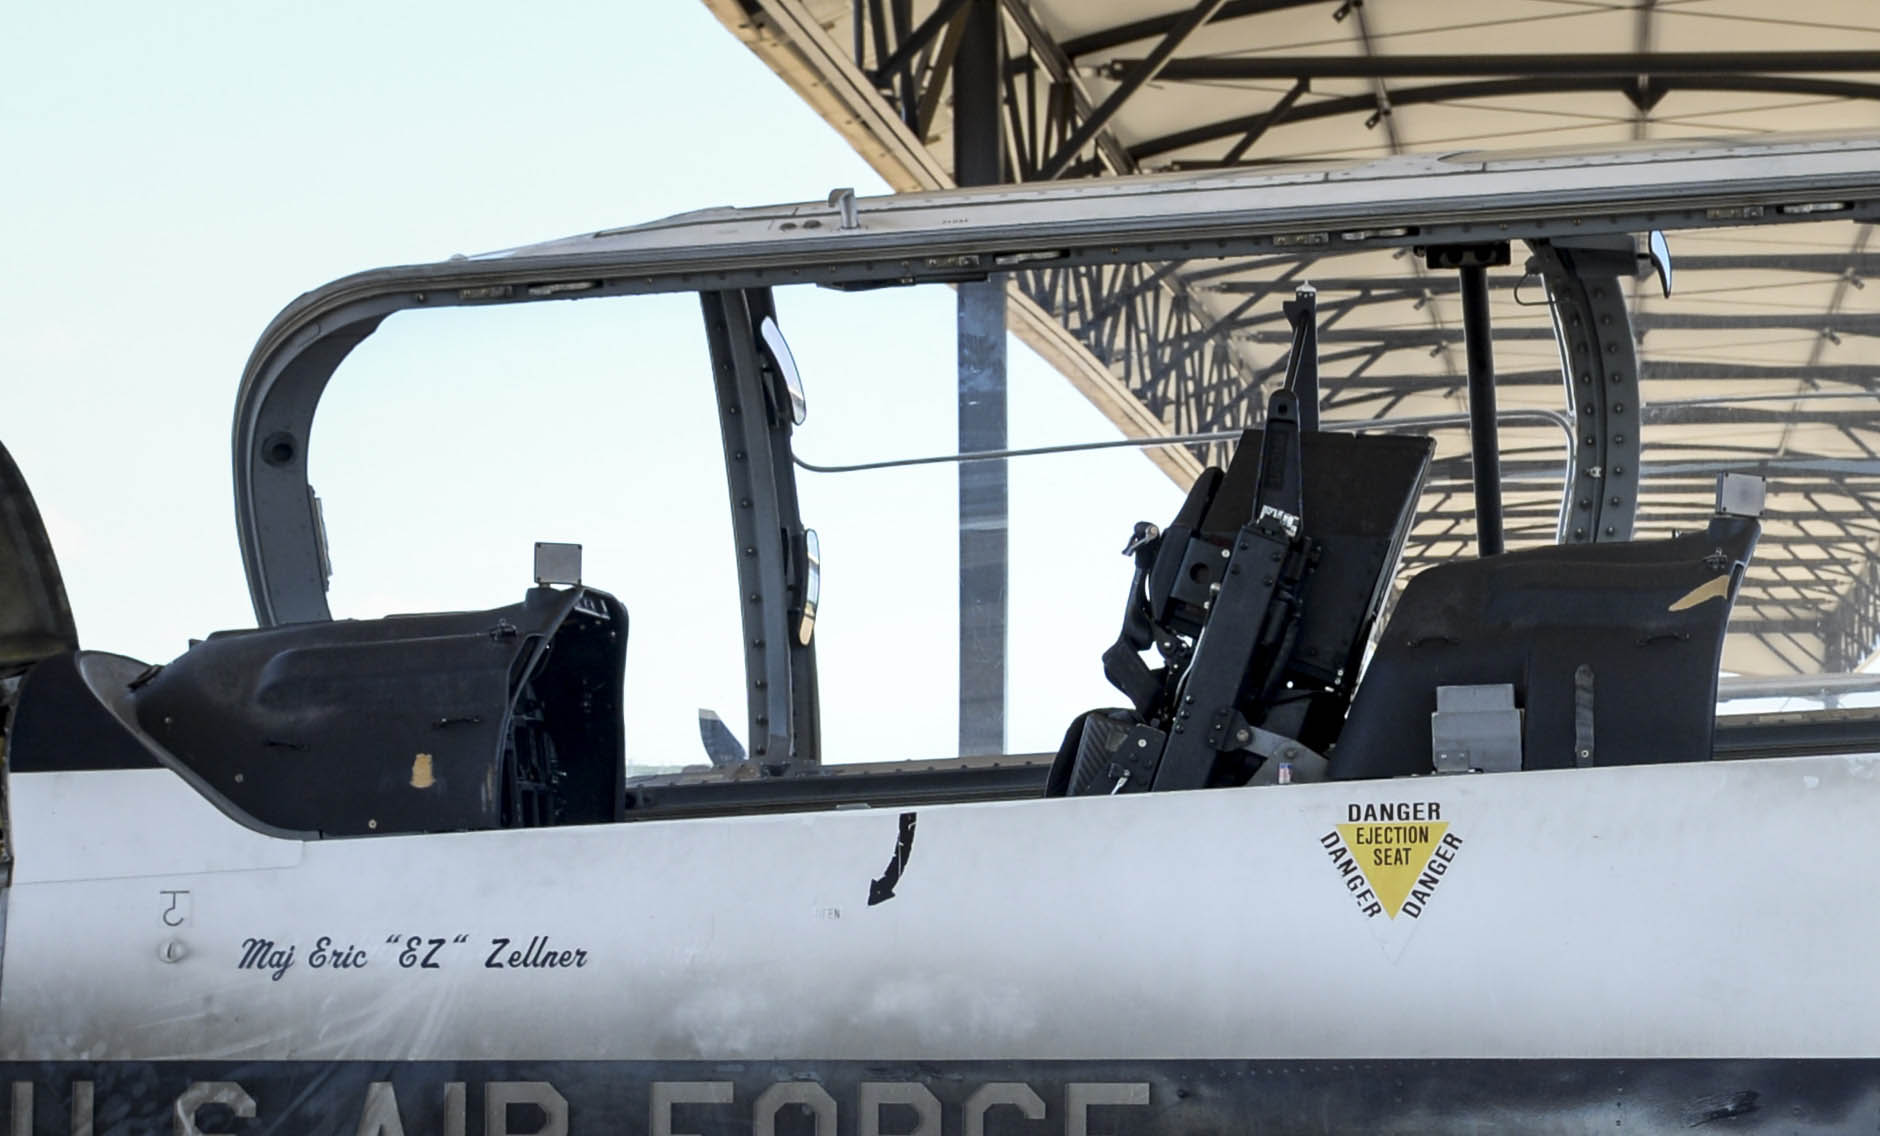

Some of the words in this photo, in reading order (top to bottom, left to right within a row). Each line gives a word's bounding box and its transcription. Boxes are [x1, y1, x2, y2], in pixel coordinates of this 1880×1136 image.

[1348, 802, 1441, 822] DANGER
[1356, 826, 1429, 844] EJECTION
[1373, 848, 1412, 866] SEAT
[1320, 831, 1382, 918] DANGER
[1401, 832, 1463, 919] DANGER
[238, 937, 295, 982] Maj
[308, 936, 368, 968] Eric
[485, 936, 588, 969] Zellner
